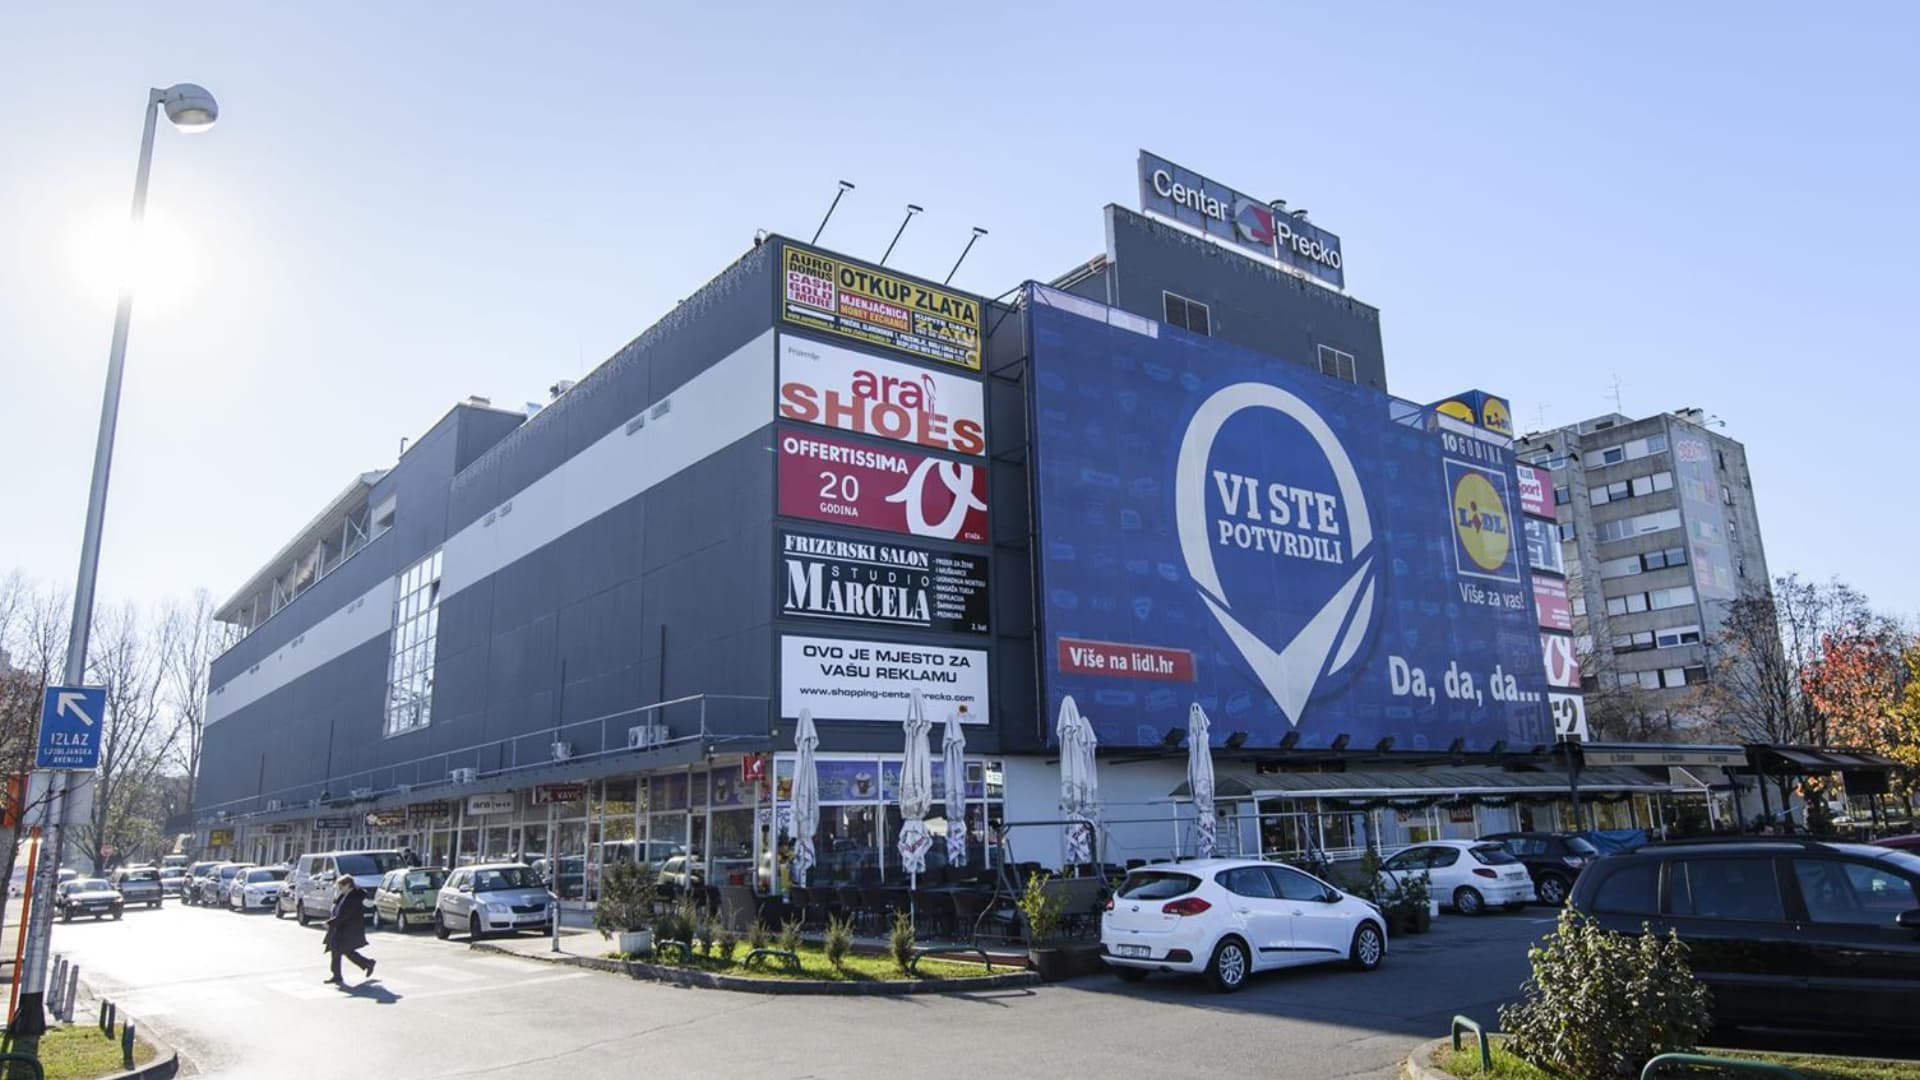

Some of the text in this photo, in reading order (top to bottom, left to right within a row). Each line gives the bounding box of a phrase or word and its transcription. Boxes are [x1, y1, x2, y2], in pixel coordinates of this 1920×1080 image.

[1153, 169, 1341, 269] Centar Precko
[789, 262, 833, 282] DOMUS
[790, 253, 833, 272] AURO
[789, 272, 833, 291] CASH
[789, 282, 833, 301] GOLD
[840, 268, 975, 322] OTKUP ZLATA
[795, 292, 833, 309] MORE
[852, 370, 923, 410] ara
[780, 382, 985, 455] SHOES
[783, 438, 908, 474] OFFERTISSIMA
[1441, 433, 1504, 464] 10 GODINA
[819, 471, 859, 502] 20
[820, 502, 858, 517] GODINA
[1213, 470, 1340, 536] VI STE
[784, 534, 929, 567] FRIZERSKI SALON
[1218, 519, 1343, 564] POTVRDILI
[784, 559, 931, 621] MARCELA
[831, 565, 930, 587] STUDIO
[1459, 582, 1525, 609] Više za vas!
[804, 645, 971, 668] OVO JE MJESTO ZA
[1069, 646, 1174, 674] Više na lidl.hr
[821, 662, 957, 683] VAŠU REKLAMU
[1388, 655, 1540, 707] Da, da, da...
[51, 732, 89, 746] IZLAZ
